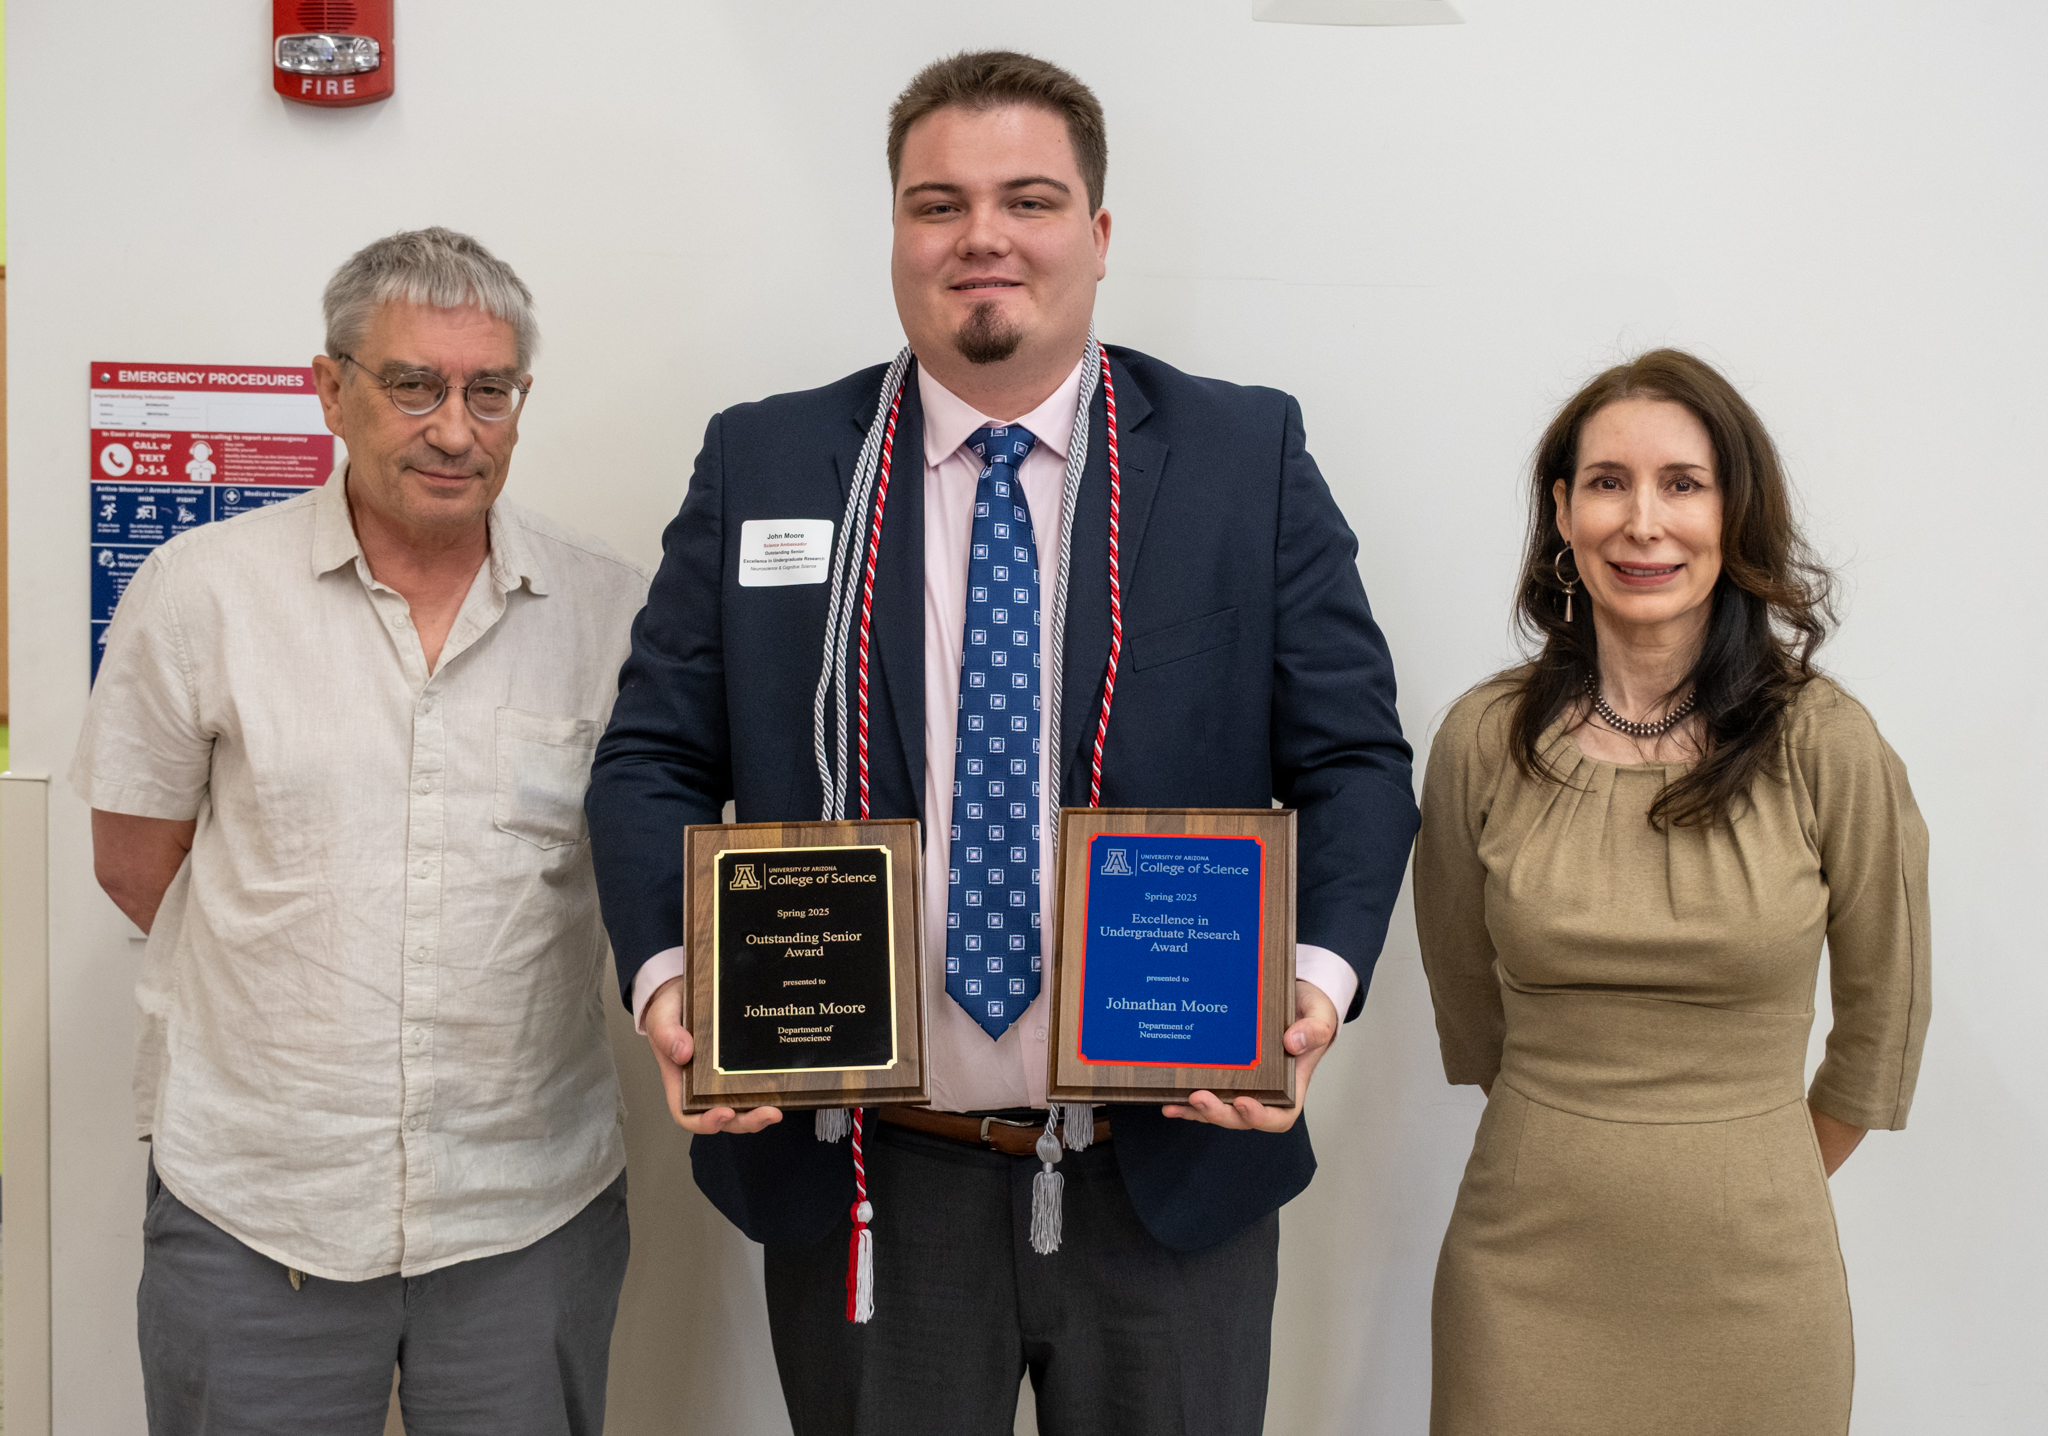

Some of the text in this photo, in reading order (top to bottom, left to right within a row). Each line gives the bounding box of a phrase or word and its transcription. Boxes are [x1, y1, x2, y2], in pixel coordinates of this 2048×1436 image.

[301, 79, 355, 95] FIRE
[118, 370, 304, 387] EMERGENCY PROCEDURES
[132, 441, 159, 450] CALL
[139, 454, 166, 462] TEXT
[135, 464, 169, 475] 9-1-1
[1140, 862, 1249, 876] College of Science
[768, 873, 877, 887] College of Science
[1144, 892, 1198, 902] Spring 2025
[777, 908, 830, 919] Spring 2025
[1132, 913, 1209, 925] Excellence in
[746, 931, 862, 945] Outstanding Senior
[1100, 926, 1241, 940] Undergraduate Research
[784, 946, 824, 958] Award
[1150, 942, 1188, 953] Award
[783, 978, 817, 987] presented
[1146, 975, 1181, 983] presented
[743, 1002, 866, 1018] Johnathan Moore
[1106, 997, 1229, 1014] Johnathan Moore
[777, 1024, 834, 1036] Department of
[1138, 1021, 1195, 1031] Department of
[779, 1034, 831, 1043] Neuroscience
[1139, 1031, 1191, 1040] Neuroscience
